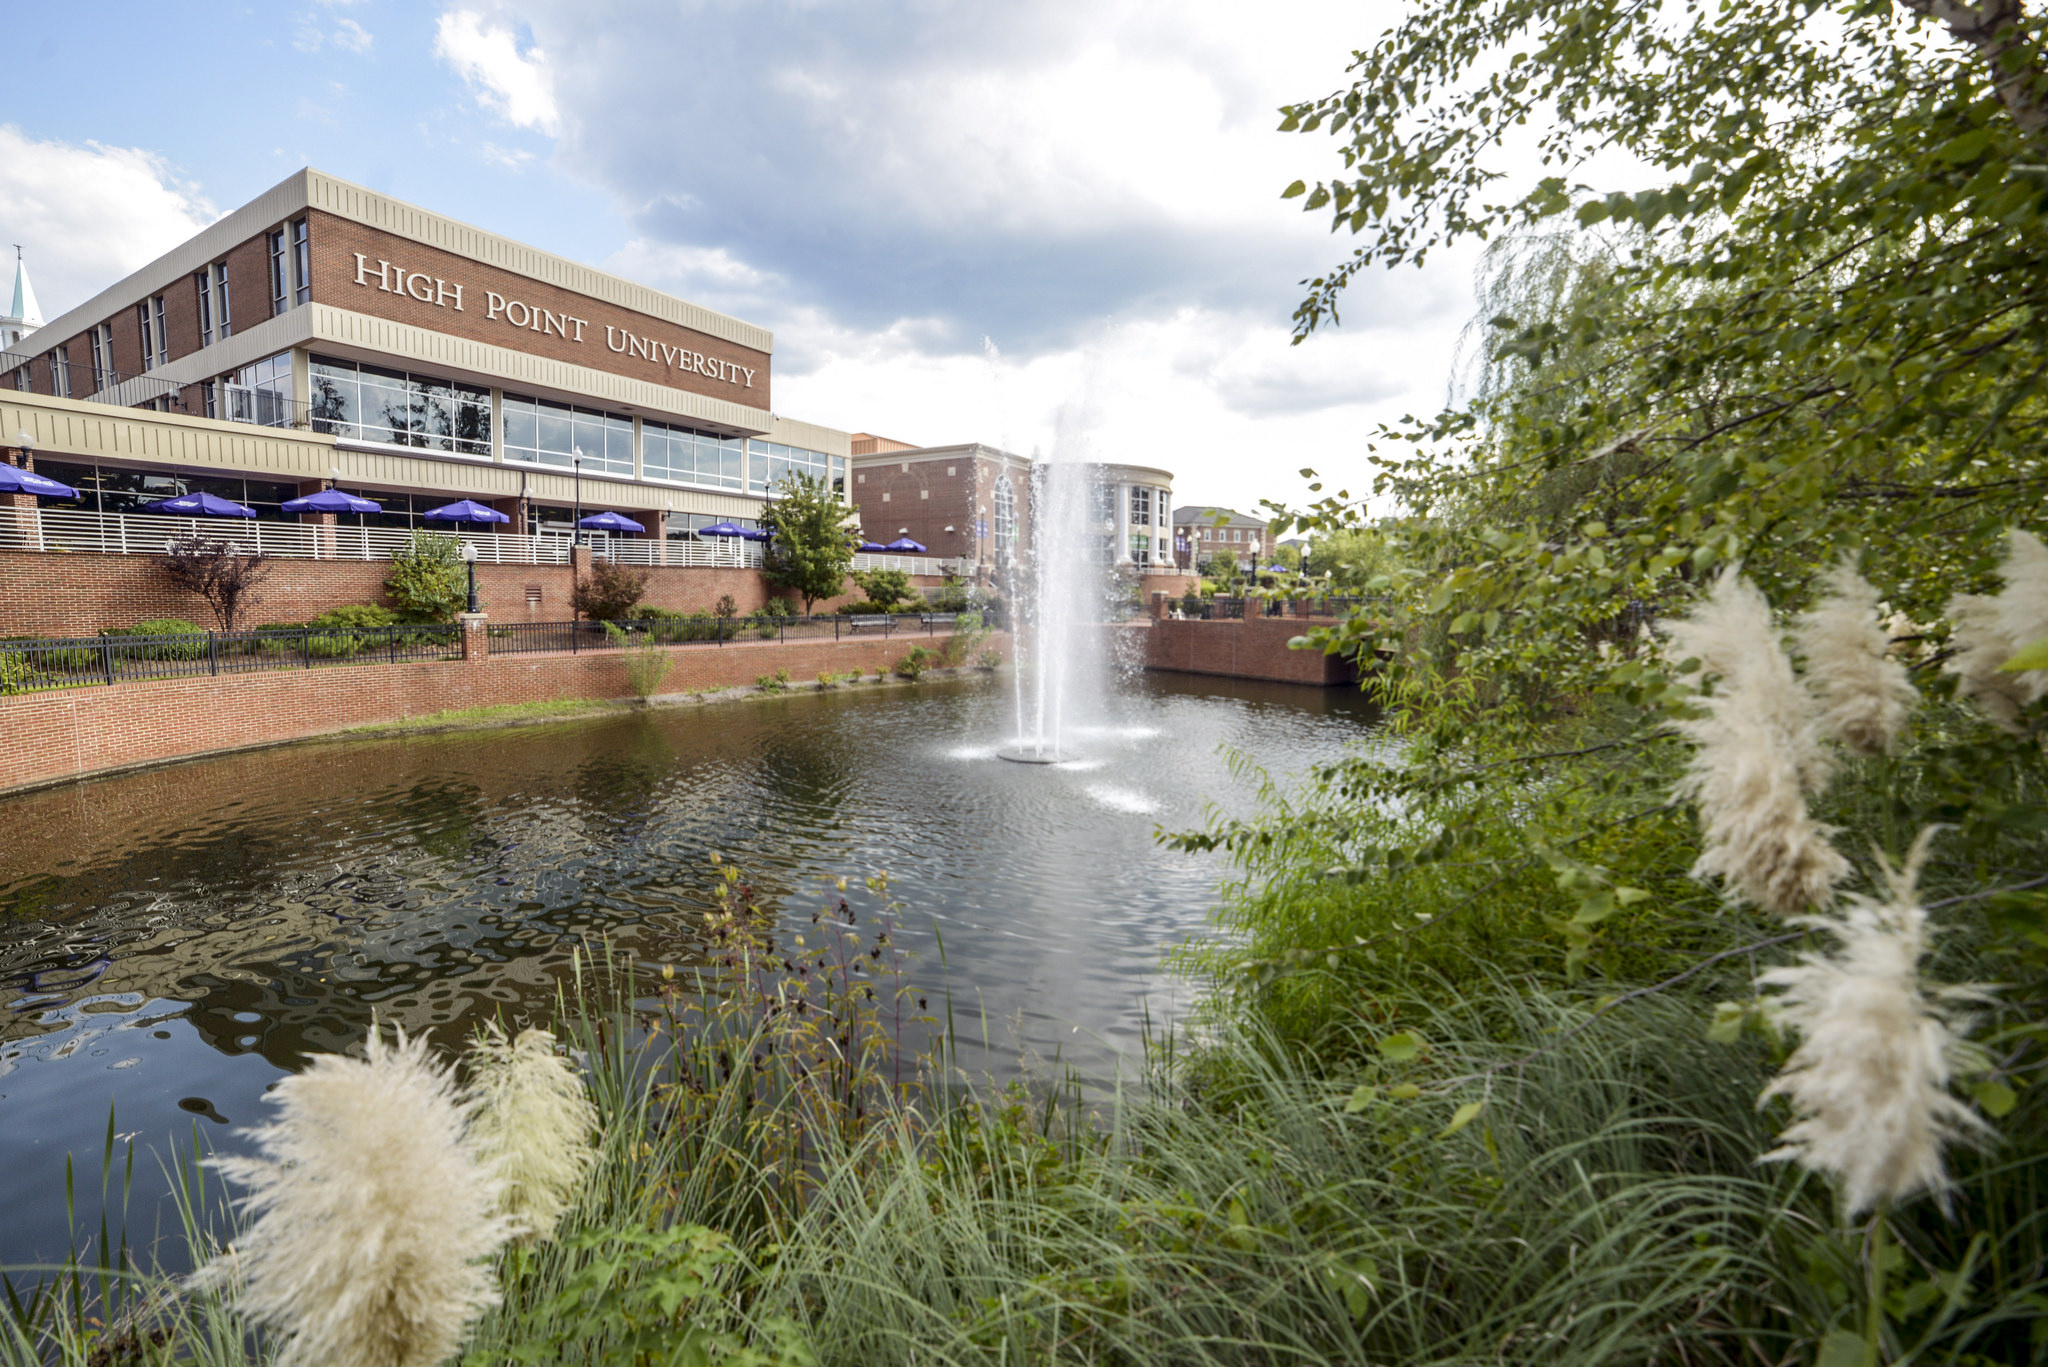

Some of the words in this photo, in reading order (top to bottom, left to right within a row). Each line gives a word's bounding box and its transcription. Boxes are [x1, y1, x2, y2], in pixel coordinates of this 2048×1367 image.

[353, 252, 464, 312] HIGH
[485, 290, 588, 343] POINT
[605, 324, 756, 388] UNIVERSITY
